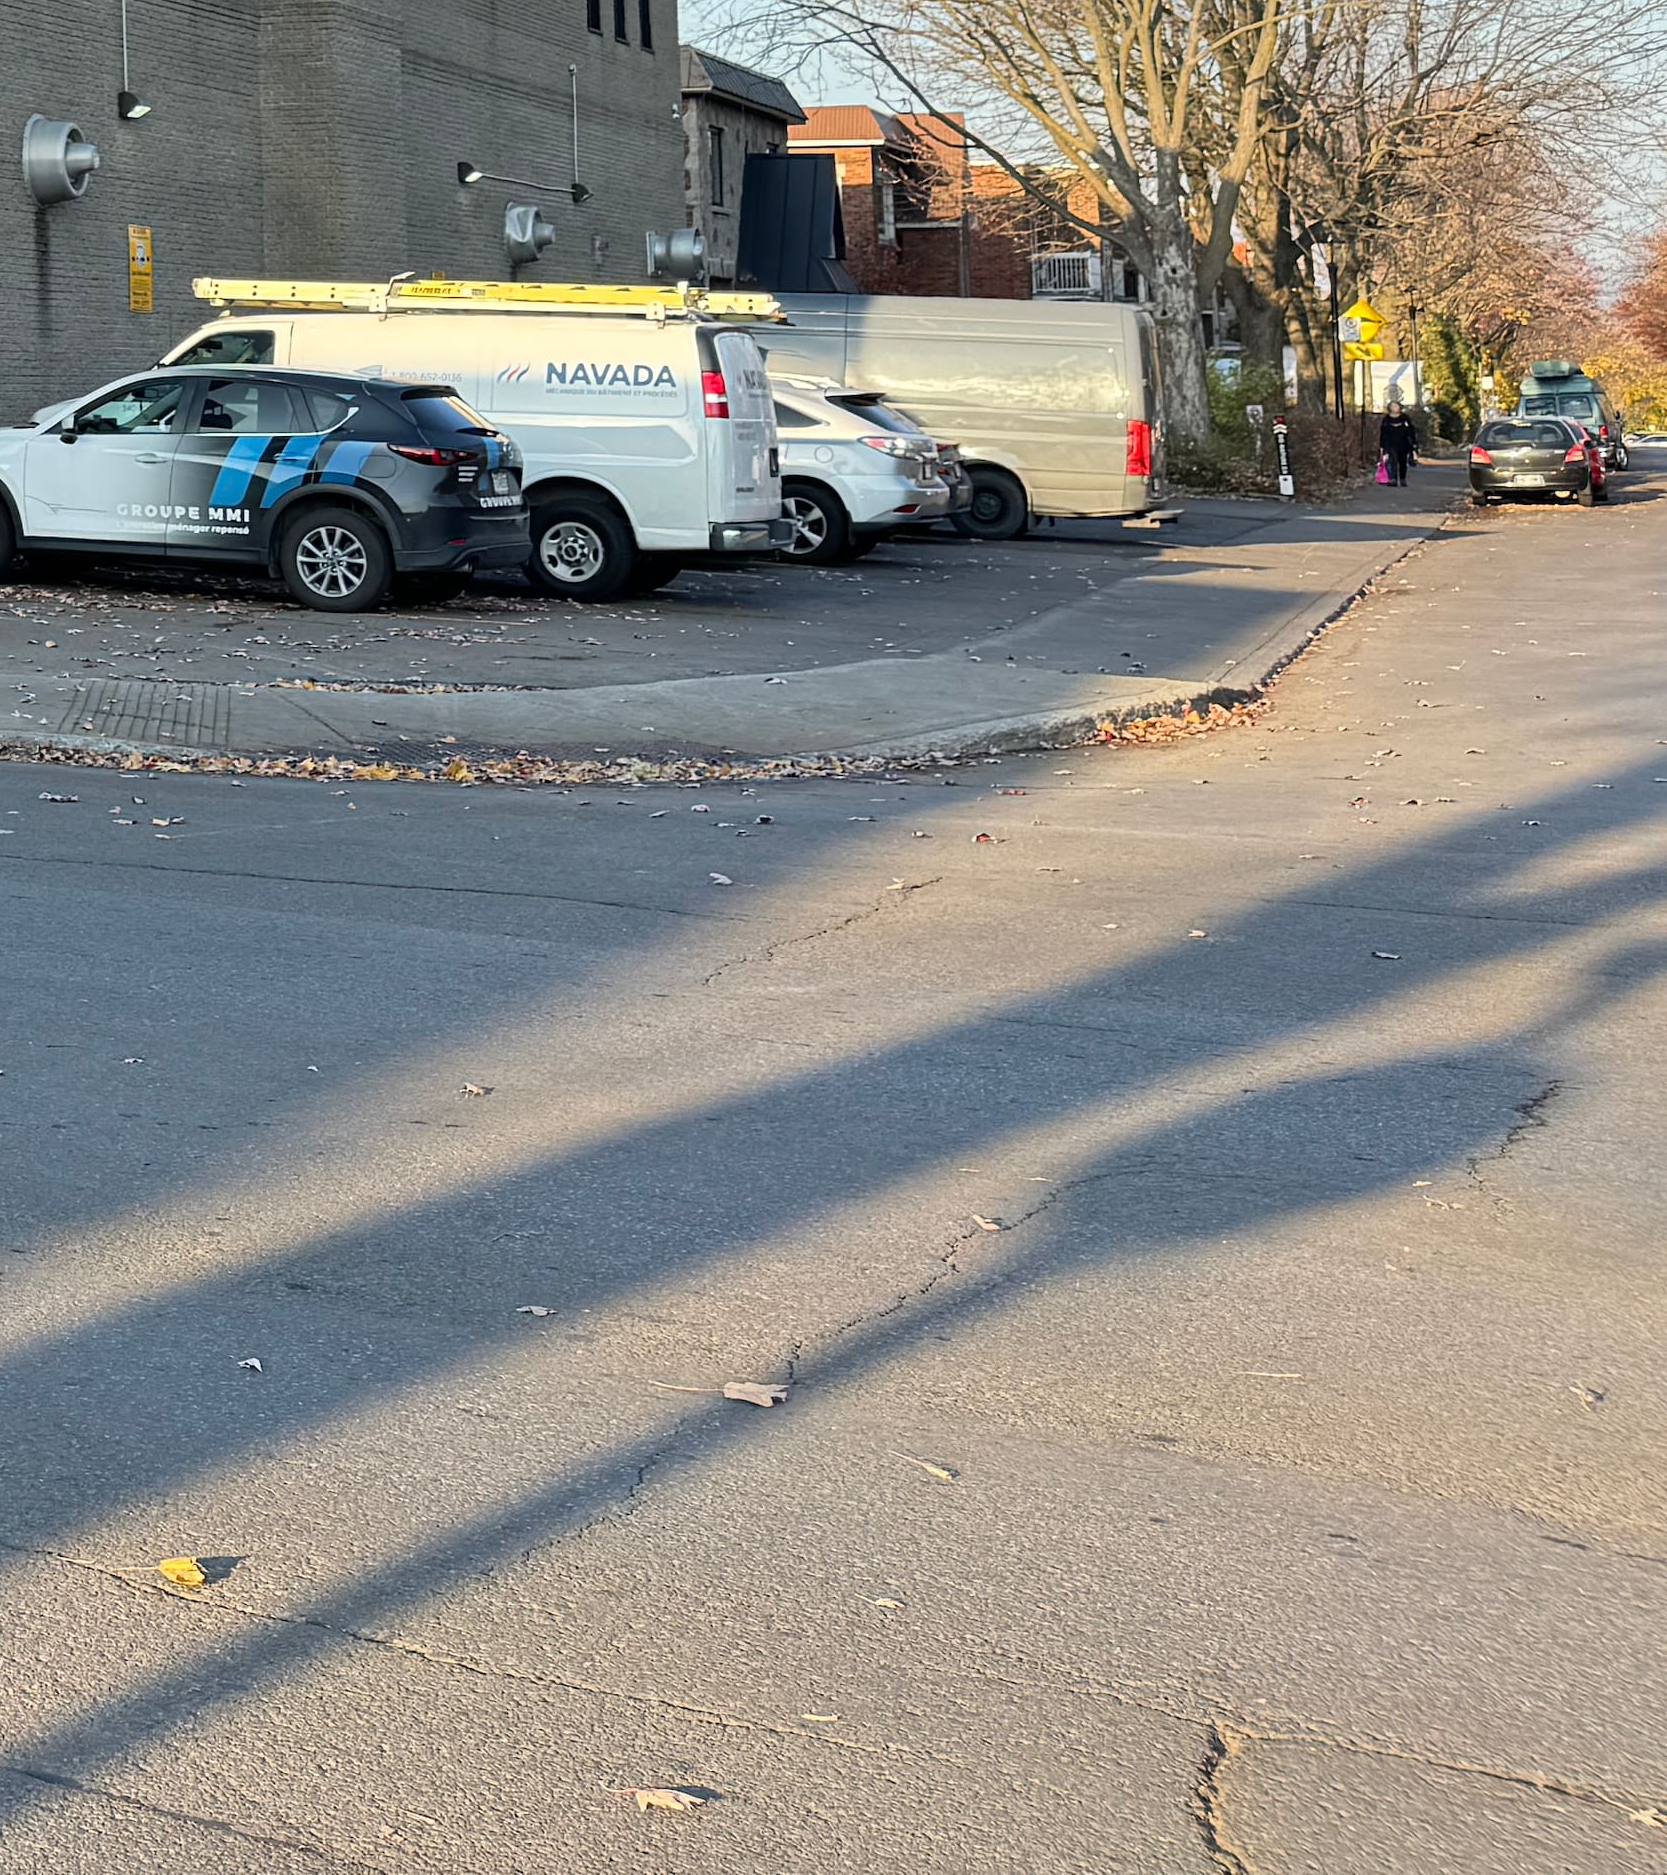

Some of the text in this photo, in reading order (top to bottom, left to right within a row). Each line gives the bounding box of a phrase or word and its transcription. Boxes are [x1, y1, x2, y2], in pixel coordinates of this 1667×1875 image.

[546, 362, 677, 387] NAVADA
[117, 503, 250, 523] GROUPE MMI
